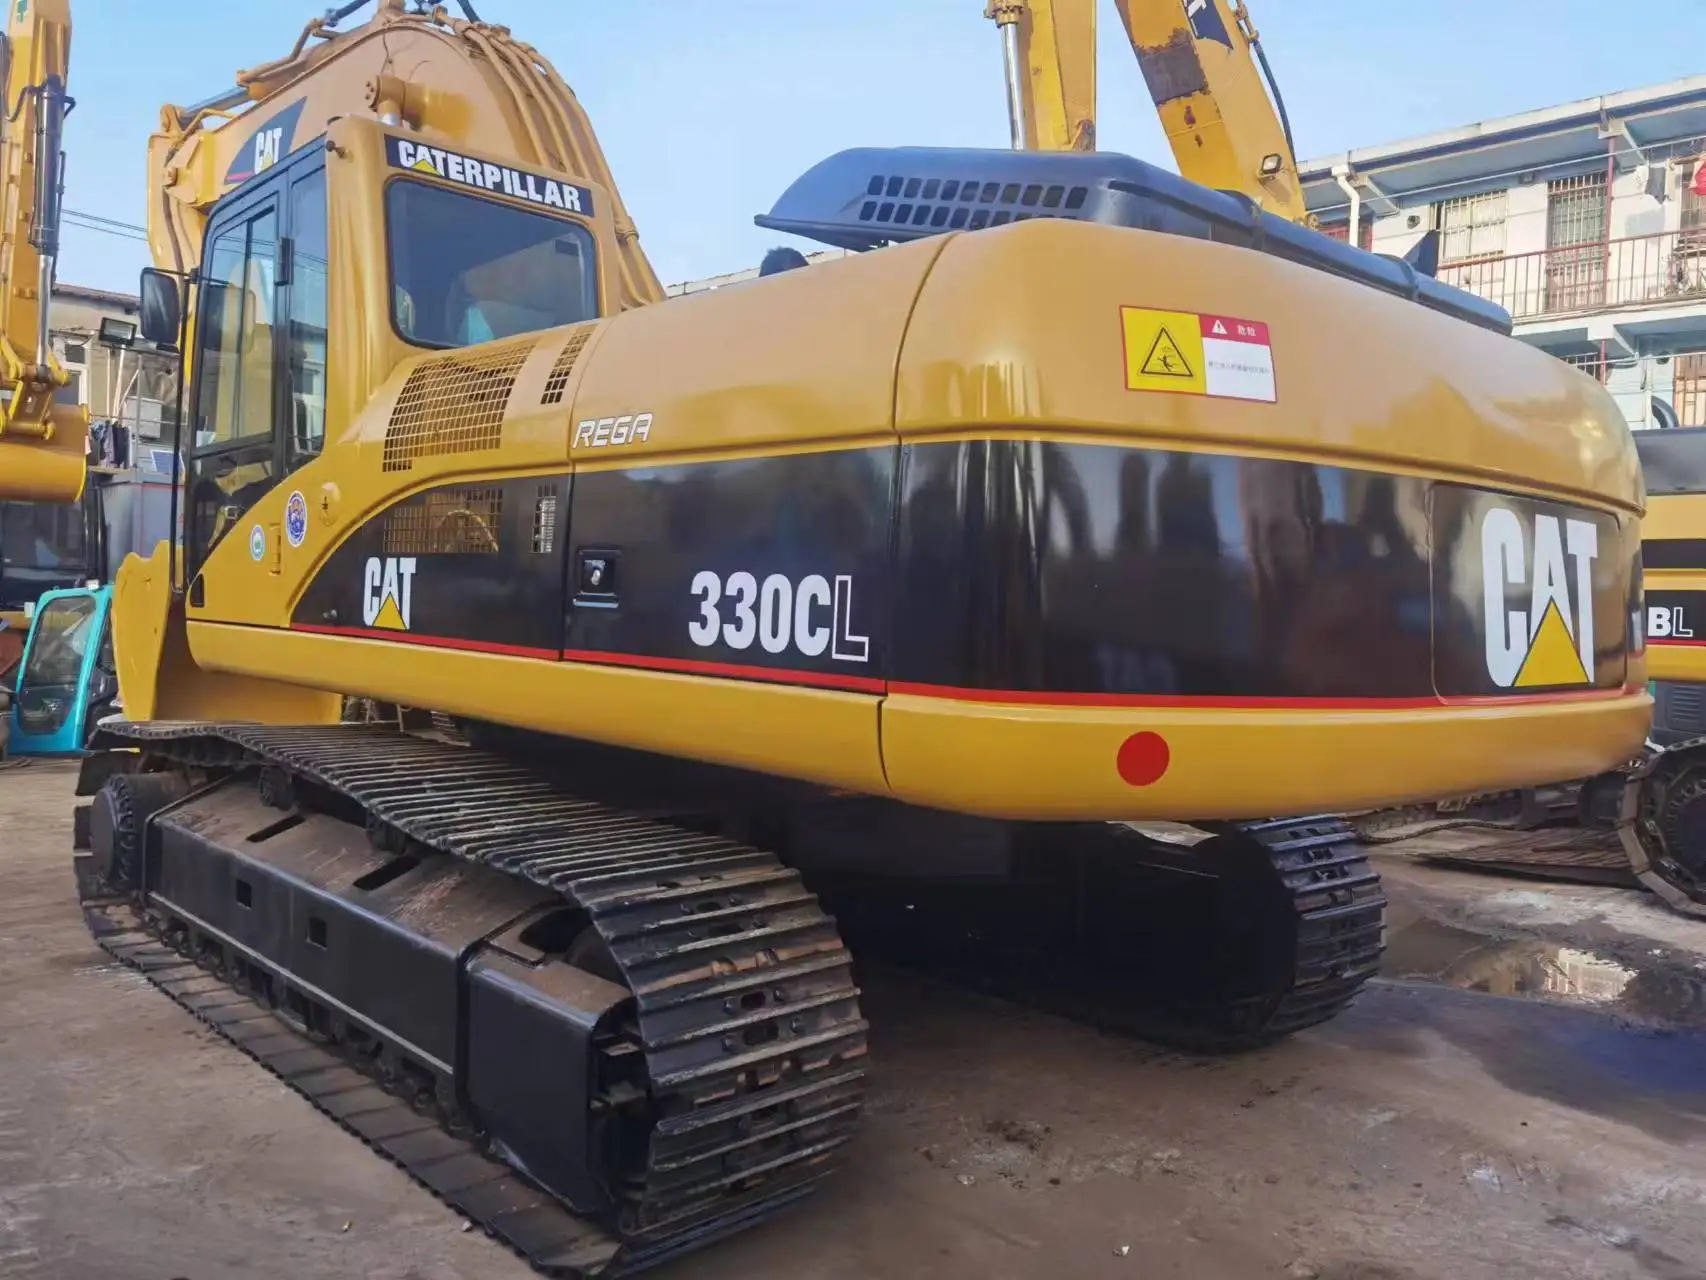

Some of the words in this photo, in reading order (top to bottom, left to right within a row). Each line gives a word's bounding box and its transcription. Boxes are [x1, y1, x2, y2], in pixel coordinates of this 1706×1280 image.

[254, 127, 282, 175] CAT
[397, 140, 581, 212] CATERPILLAR
[572, 412, 653, 449] REGA
[363, 557, 417, 630] CAT
[688, 570, 869, 662] 330CL
[1481, 508, 1598, 687] CAT
